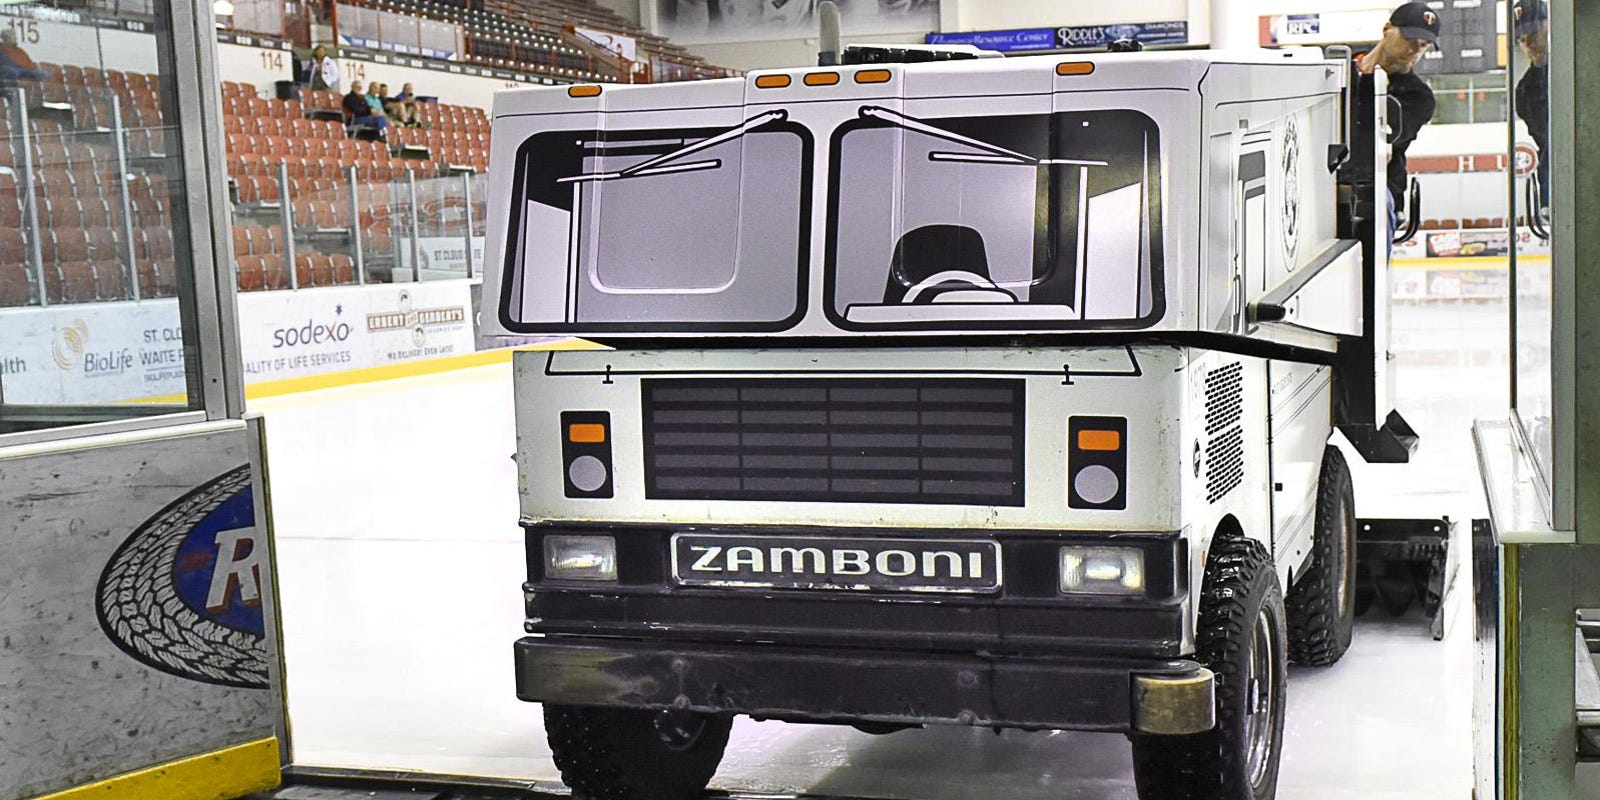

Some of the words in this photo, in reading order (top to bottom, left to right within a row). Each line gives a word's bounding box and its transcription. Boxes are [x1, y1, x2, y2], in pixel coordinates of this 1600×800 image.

[1016, 31, 1049, 42] Center
[260, 51, 284, 71] 114
[346, 63, 365, 80] 114
[163, 328, 183, 341] CLO
[273, 319, 349, 348] sodexo
[84, 348, 133, 374] BioLife
[140, 349, 176, 366] WAITE
[245, 359, 272, 374] ALITY
[274, 358, 285, 371] OF
[288, 355, 308, 369] LIFE
[310, 350, 352, 367] SERVICES
[690, 545, 983, 579] ZAMBONI
